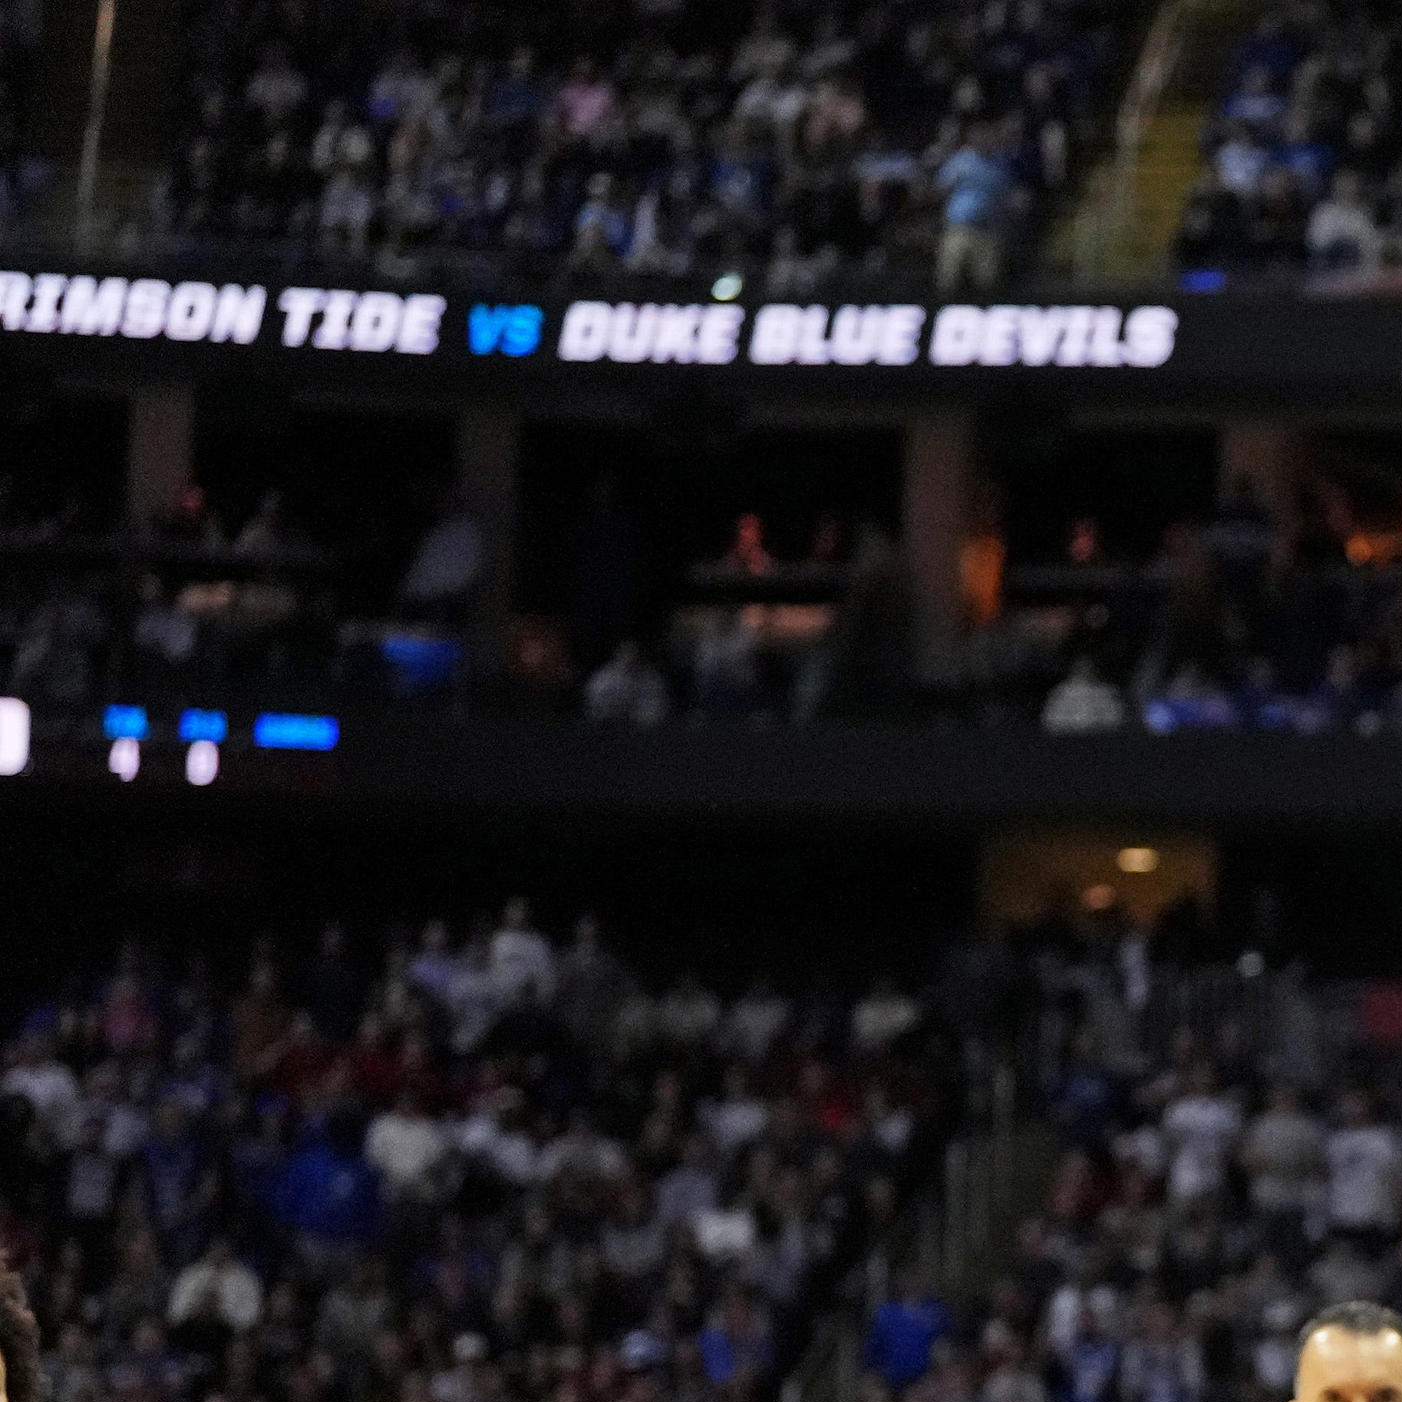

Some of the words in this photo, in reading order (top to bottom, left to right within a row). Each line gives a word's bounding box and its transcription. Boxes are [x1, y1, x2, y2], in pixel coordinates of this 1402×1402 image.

[0, 271, 266, 344] RIMSON
[277, 286, 446, 354] TIDE
[467, 303, 544, 356] VS
[558, 301, 745, 364] DUKE
[748, 303, 926, 366] BLUE
[928, 304, 1178, 368] DEVILS
